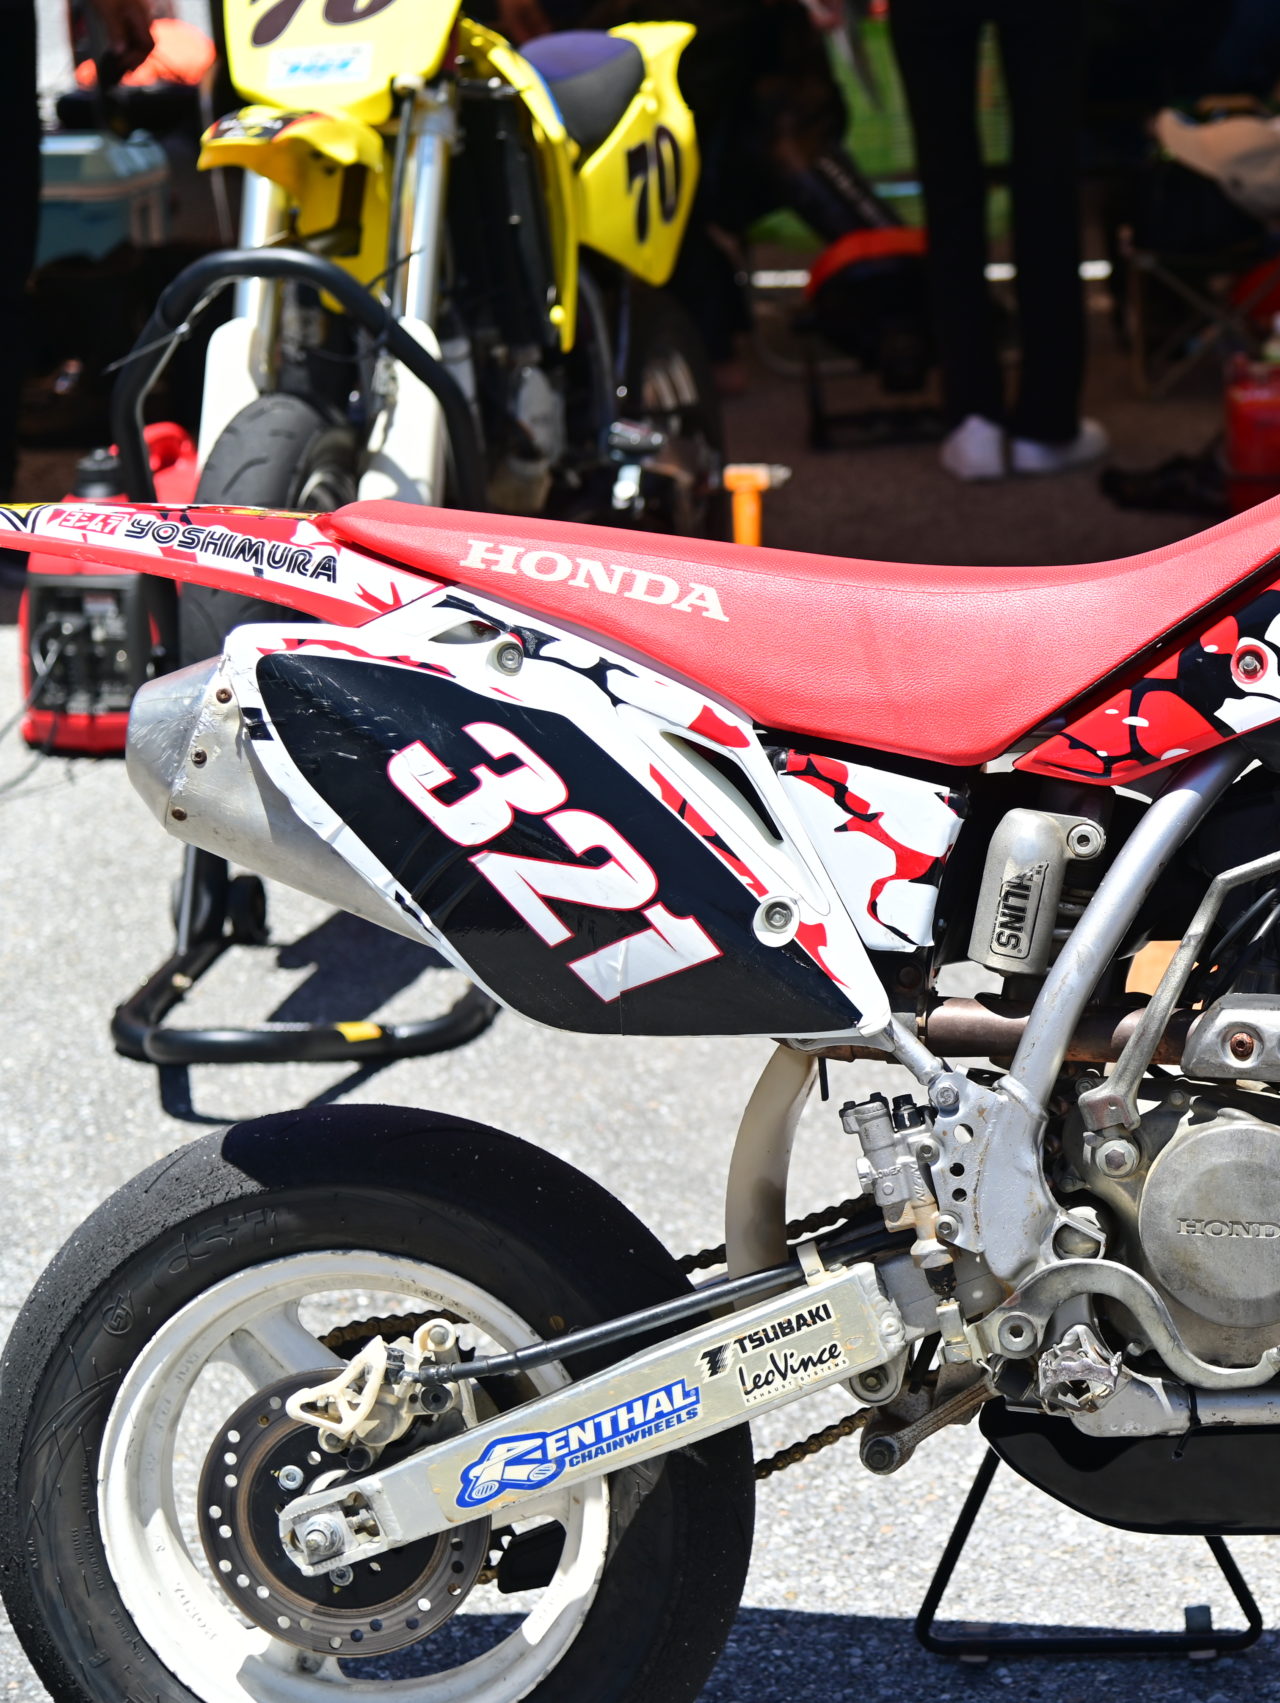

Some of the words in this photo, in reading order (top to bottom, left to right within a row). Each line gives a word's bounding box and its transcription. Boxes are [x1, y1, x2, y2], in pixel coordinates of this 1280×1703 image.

[627, 124, 683, 246] 70
[124, 516, 338, 584] YOSHIMURA
[460, 539, 730, 622] HONDA
[387, 721, 723, 1003] 321
[734, 1303, 832, 1355] TSUBAKI
[739, 1343, 842, 1396] LeoVince
[746, 1381, 793, 1403] EXHAUST
[800, 1359, 847, 1382] SYSTEMS
[568, 1407, 699, 1468] CHAINWHEELS
